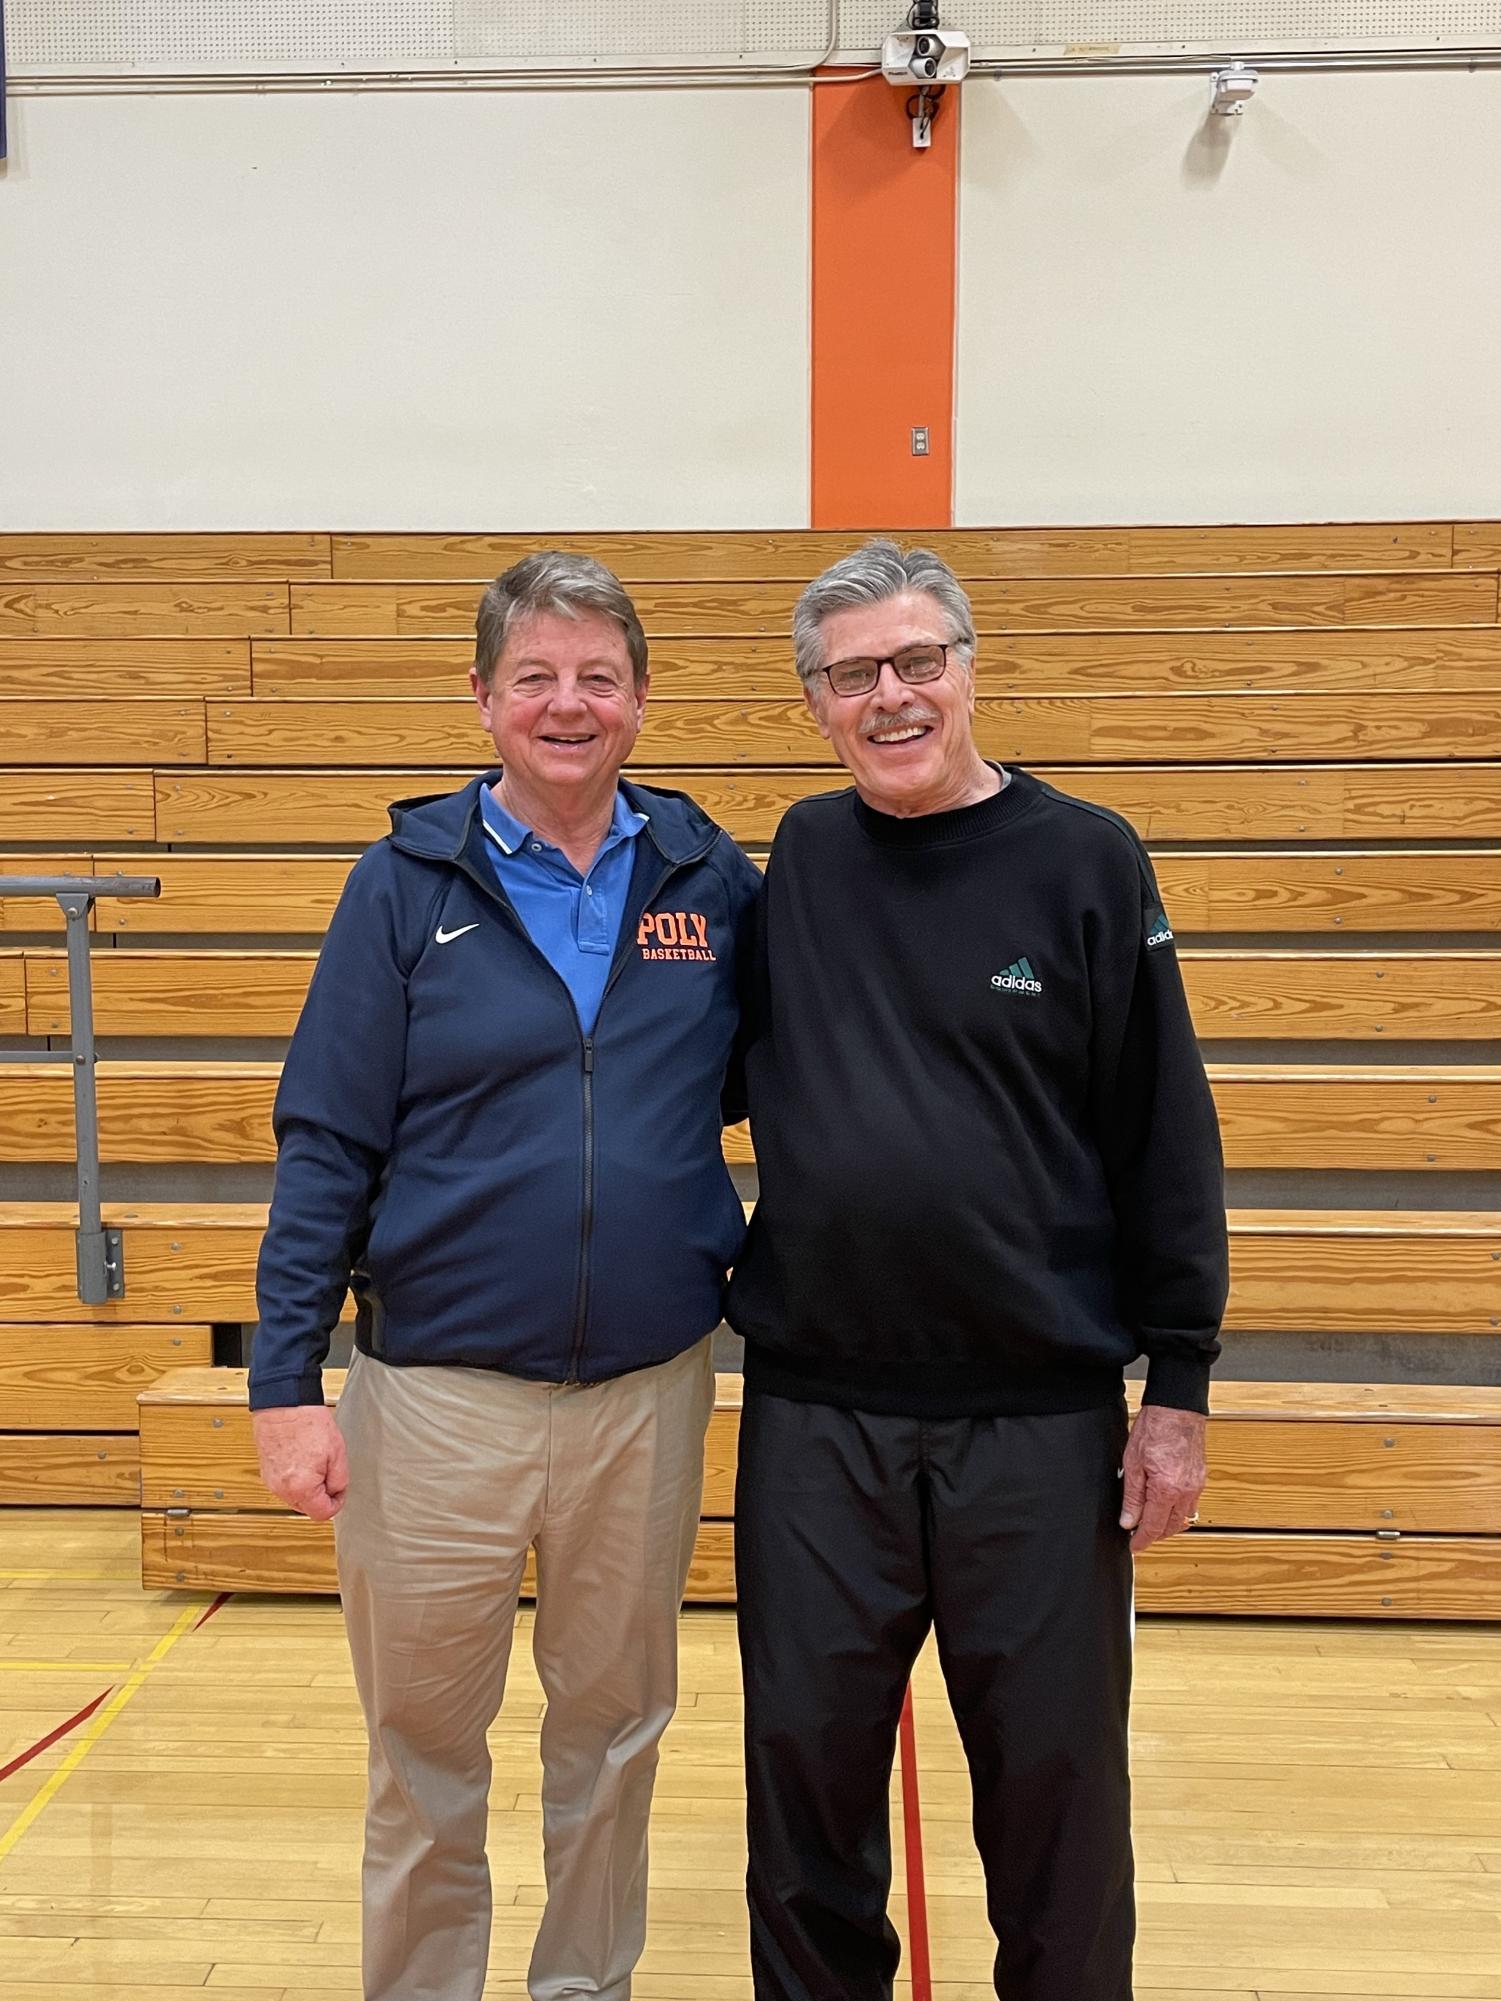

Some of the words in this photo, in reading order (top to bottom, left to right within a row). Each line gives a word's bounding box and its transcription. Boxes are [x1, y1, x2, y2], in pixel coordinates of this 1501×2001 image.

[637, 912, 708, 947] POLY
[1147, 929, 1174, 946] adid
[642, 948, 717, 961] BASKETBALL
[991, 975, 1042, 992] adidas
